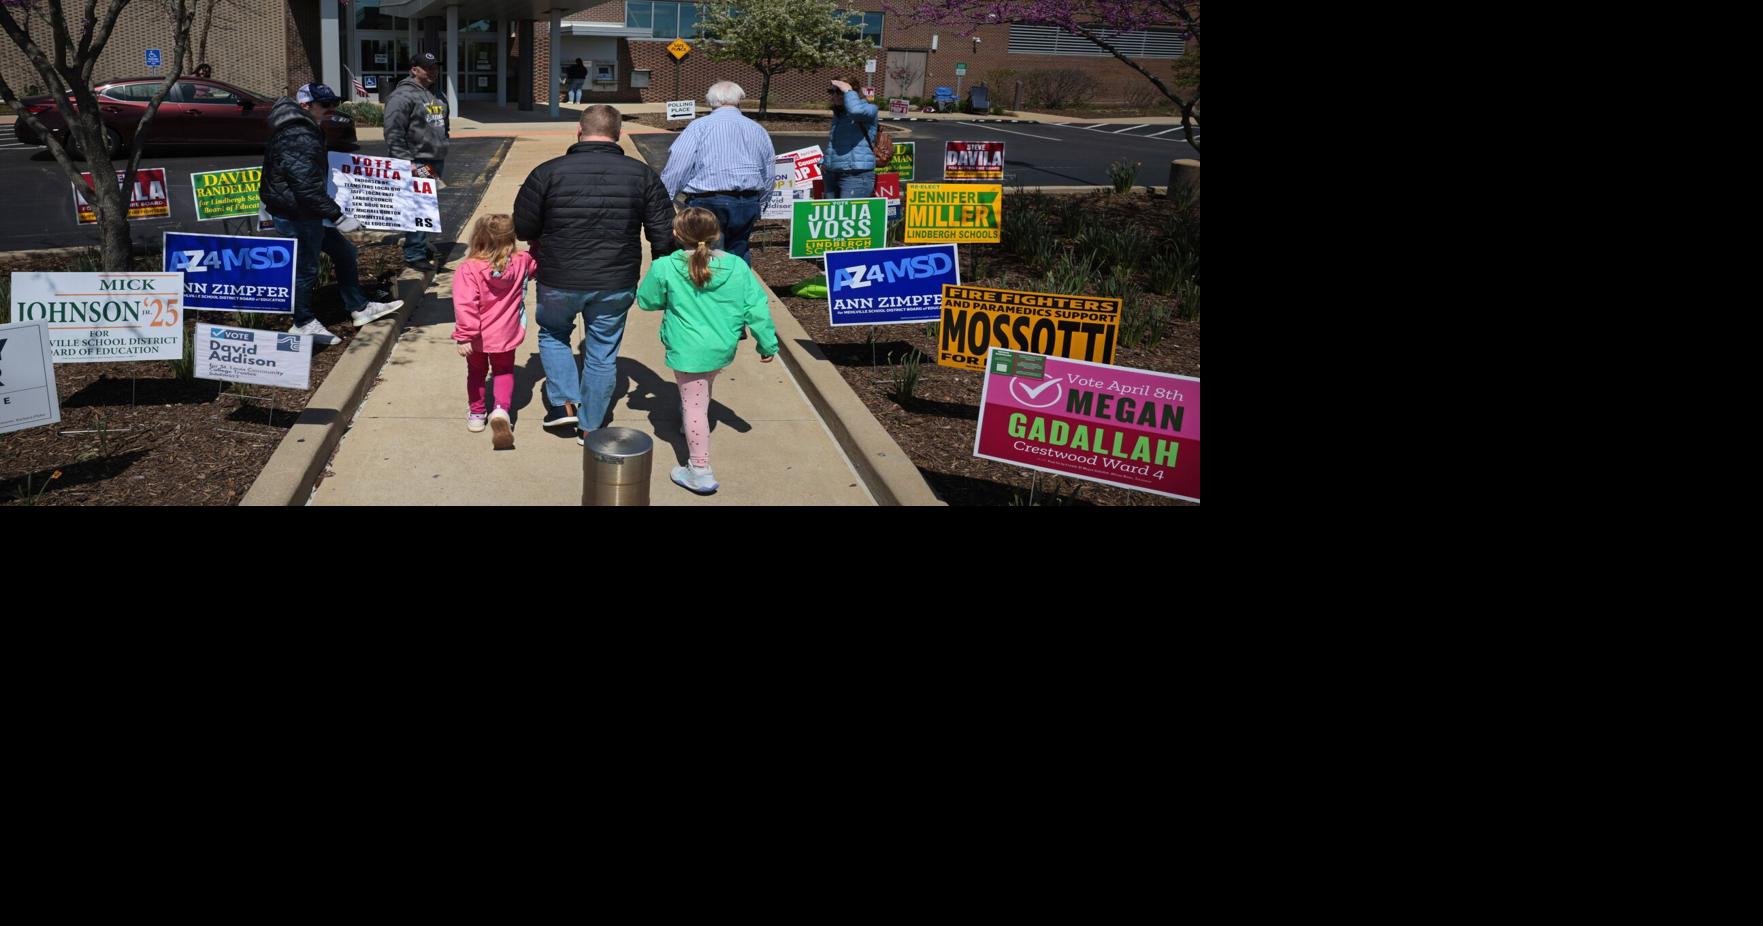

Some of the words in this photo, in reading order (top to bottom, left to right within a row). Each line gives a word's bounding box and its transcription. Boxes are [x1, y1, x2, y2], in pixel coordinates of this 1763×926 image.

[352, 156, 392, 170] VOTE
[946, 150, 1002, 166] DAVILA
[203, 169, 262, 187] DAVID
[342, 164, 400, 180] DAVILA
[197, 183, 260, 198] RANDELMA
[413, 181, 432, 194] LA
[910, 191, 975, 203] JENNIFER
[808, 204, 871, 221] JULIA
[909, 205, 990, 227] MILLER
[415, 217, 433, 228] RS
[808, 220, 871, 238] VOSS
[959, 230, 998, 238] SCHOOLS
[806, 240, 871, 248] LINDBERGH
[169, 246, 290, 272] AZ4MSD
[833, 253, 952, 292] AZ4MSD
[100, 279, 155, 290] MICK
[184, 282, 207, 294] NN
[212, 284, 289, 297] ZIMPFER
[834, 298, 873, 310] ANN
[878, 294, 942, 308] ZIMPFE
[950, 288, 996, 301] FIRE
[1001, 293, 1114, 310] FIGHTERS
[18, 301, 141, 323] JOHNSON
[945, 300, 970, 308] AND
[973, 302, 1052, 317] PARAMEDICS
[1055, 310, 1117, 322] SUPPORT
[50, 339, 79, 347] VILLE
[82, 338, 126, 346] SCHOOL
[225, 332, 249, 340] VOTE
[942, 308, 1116, 364] MOSSOTTI
[51, 348, 76, 356] ARD
[96, 346, 159, 355] EDUCATION
[210, 340, 257, 355] David
[209, 351, 276, 367] Addison
[942, 353, 979, 364] FOR
[247, 368, 284, 376] Community
[1067, 373, 1103, 388] Vote
[1106, 380, 1150, 396] April
[1153, 388, 1184, 402] 8th
[1066, 389, 1184, 432] MEGAN
[1008, 412, 1179, 468] GADALLAH
[1014, 441, 1098, 466] Crestwood
[1103, 458, 1149, 476] Ward
[1152, 470, 1165, 480] 4
